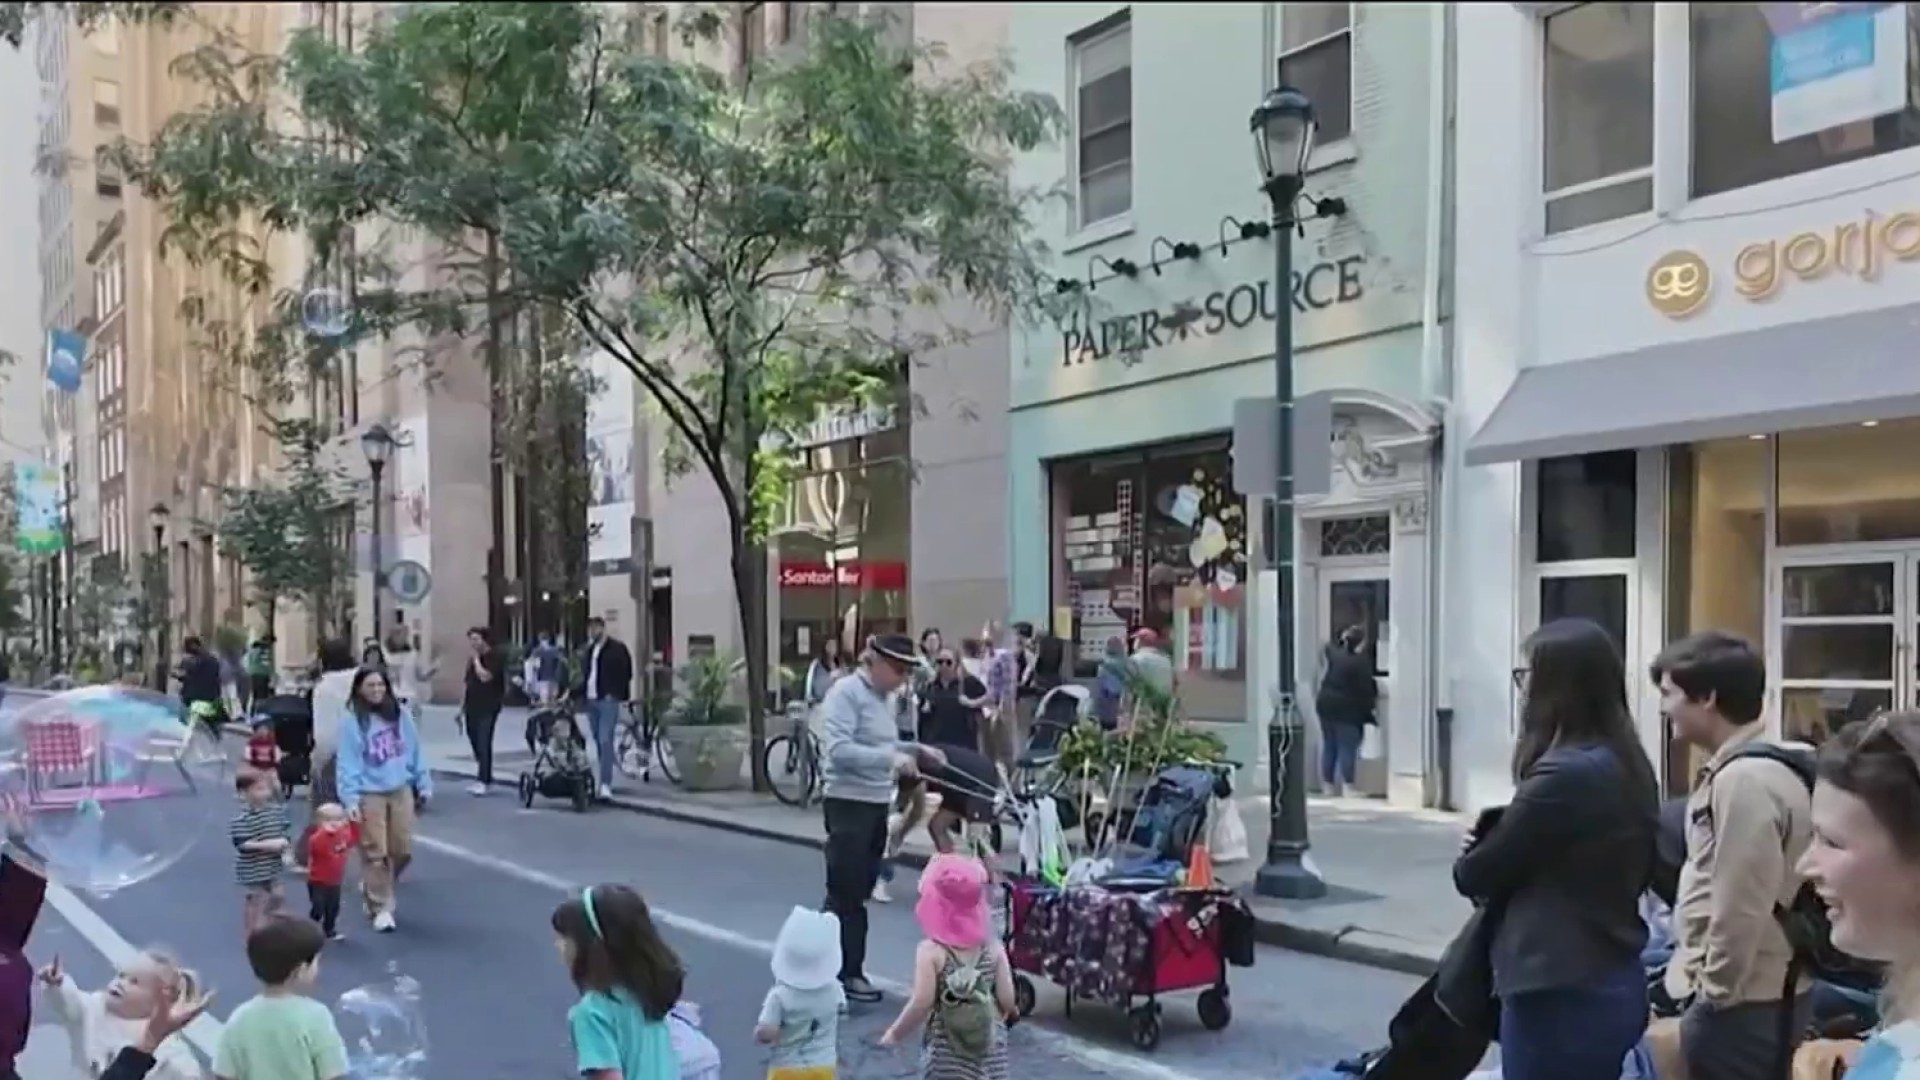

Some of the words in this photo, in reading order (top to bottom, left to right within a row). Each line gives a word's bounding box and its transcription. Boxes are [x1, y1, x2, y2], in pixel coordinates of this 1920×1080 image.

[1062, 309, 1163, 367] PAPER
[1204, 255, 1365, 334] SOURCE
[784, 567, 860, 585] Santaner
